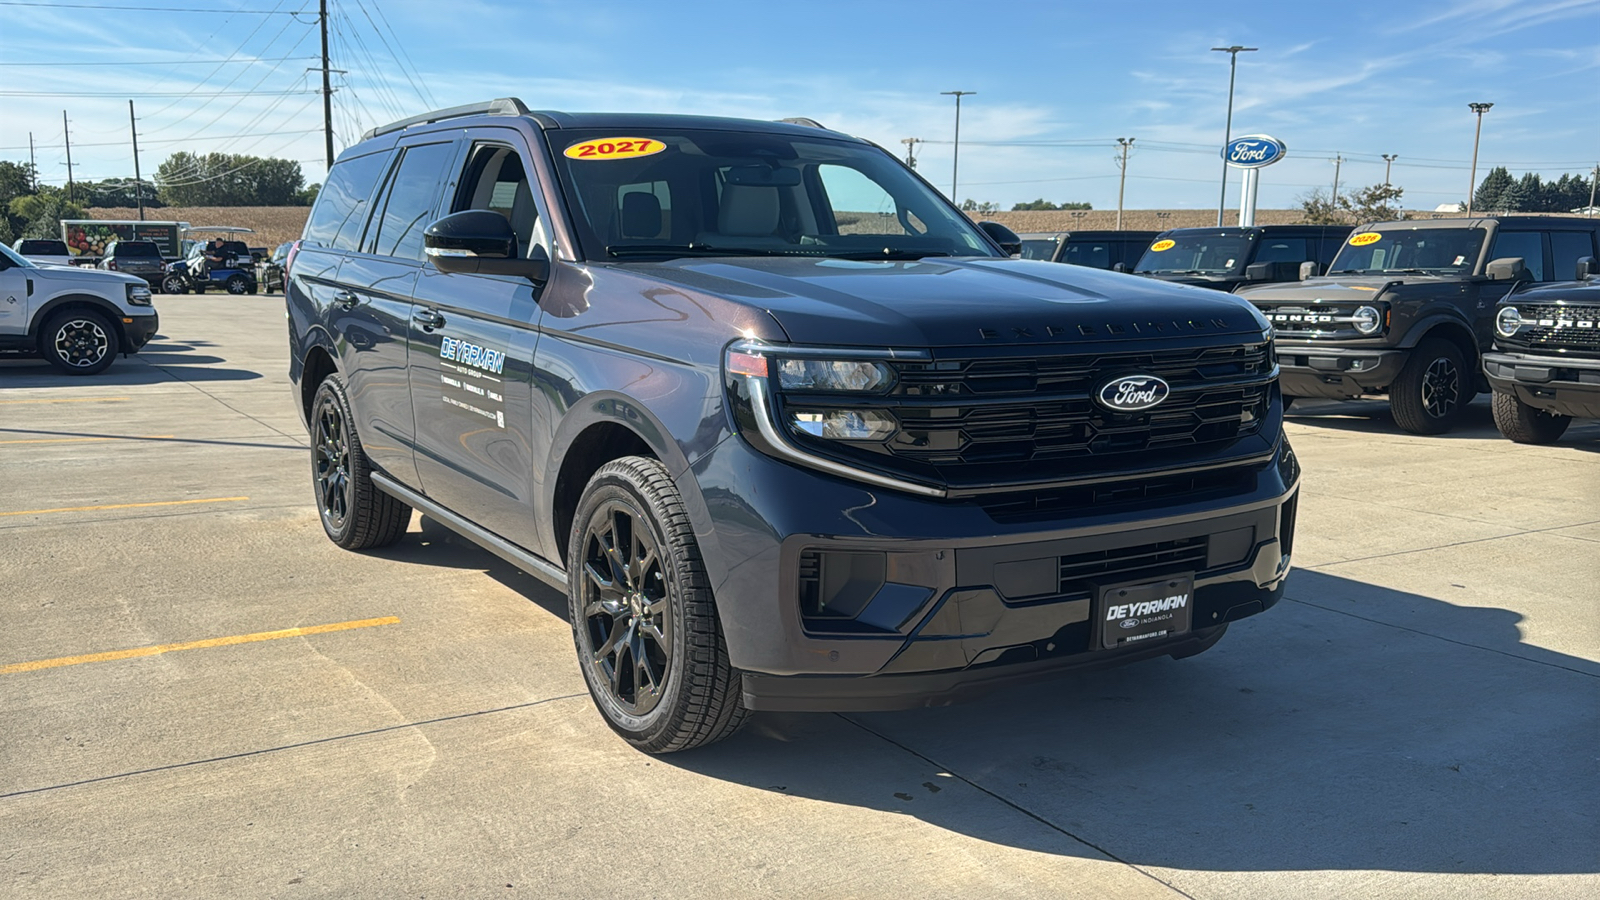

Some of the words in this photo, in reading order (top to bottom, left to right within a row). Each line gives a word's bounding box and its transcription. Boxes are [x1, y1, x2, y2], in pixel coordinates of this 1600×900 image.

[578, 140, 652, 157] 2027
[1231, 142, 1268, 161] Ford
[1352, 235, 1378, 243] 2026
[978, 318, 1229, 340] EXPEDITION
[1539, 320, 1600, 328] BRO
[440, 336, 506, 374] DEYARMAN
[1114, 380, 1157, 404] Ford
[1106, 594, 1188, 621] DEYARMAN
[1141, 613, 1173, 624] INDIANOLA
